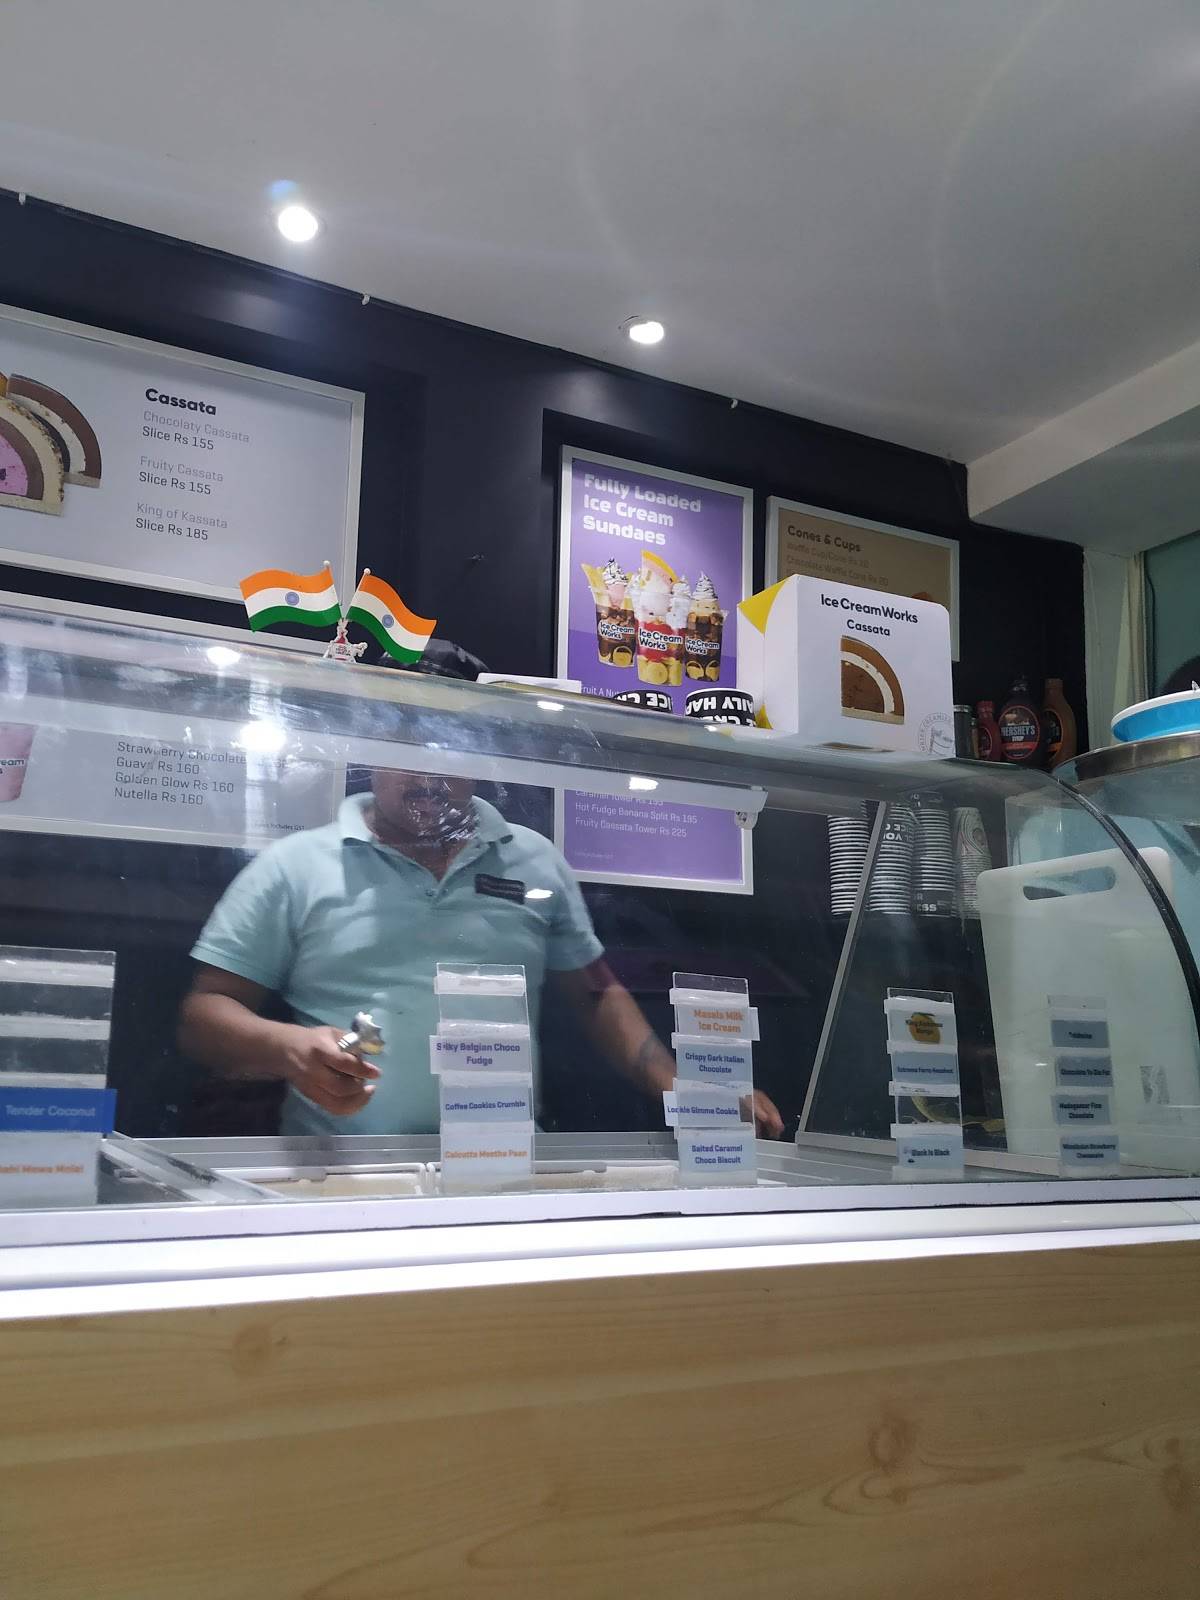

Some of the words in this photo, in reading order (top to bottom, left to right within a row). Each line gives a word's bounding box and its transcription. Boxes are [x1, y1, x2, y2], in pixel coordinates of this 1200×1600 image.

[146, 388, 216, 415] Cassata
[144, 411, 201, 433] Chocolaty
[204, 424, 250, 443] Cassata
[142, 426, 170, 441] Slice
[174, 433, 188, 445] Rs
[192, 437, 214, 450] 155
[140, 456, 174, 473] Fruity
[178, 464, 223, 482] Cassata
[139, 472, 168, 486] Slice
[171, 478, 186, 490] Rs
[189, 482, 211, 495] 155
[584, 473, 630, 500] Fully
[635, 484, 702, 513] Loaded
[136, 502, 162, 518] King
[166, 509, 178, 519] of
[182, 511, 228, 528] Kassata
[584, 494, 610, 513] Ice
[615, 502, 674, 528] Cream
[136, 518, 164, 532] Slice
[168, 524, 182, 536] Rs
[186, 527, 208, 540] 185
[584, 515, 666, 546] Sundaes
[788, 525, 822, 544] Cones
[834, 537, 861, 552] Cups
[600, 629, 622, 640] Works
[846, 619, 890, 636] Cassata
[639, 637, 666, 651] Works
[686, 646, 707, 655] Works
[158, 760, 173, 772] Rs
[176, 763, 200, 775] 160
[161, 776, 190, 790] Glow
[194, 779, 208, 792] Rs
[212, 782, 234, 794] 160
[114, 788, 158, 802] Nutella
[162, 791, 177, 804] Rs
[180, 793, 204, 806] 160
[576, 802, 590, 812] Hot
[592, 804, 616, 816] Fudge
[618, 808, 649, 819] Banana
[650, 810, 668, 821] Split
[670, 813, 680, 823] Rs
[576, 817, 598, 828] Fruity
[600, 820, 633, 832] Cassata
[636, 823, 658, 834] Tower
[660, 826, 670, 836] Rs
[672, 828, 687, 838] 225
[726, 1011, 744, 1021] Milk
[698, 1022, 712, 1032] Ice
[712, 1023, 741, 1033] Cream
[460, 1042, 492, 1054] Belgian
[494, 1043, 520, 1052] Choco
[466, 1056, 493, 1066] Fudge
[685, 1052, 706, 1062] Crispy
[708, 1054, 723, 1062] Dark
[724, 1056, 744, 1064] Italian
[699, 1064, 732, 1074] Chocolate
[6, 1104, 45, 1117] Tender
[48, 1106, 96, 1117] Coconut
[445, 1103, 468, 1111] Coffee
[469, 1102, 496, 1110] Cookies
[716, 1107, 738, 1115] Cookie
[692, 1144, 714, 1152] Salted
[714, 1144, 742, 1152] Caramel
[695, 1156, 716, 1164] Choco
[718, 1156, 741, 1164] Biscuit
